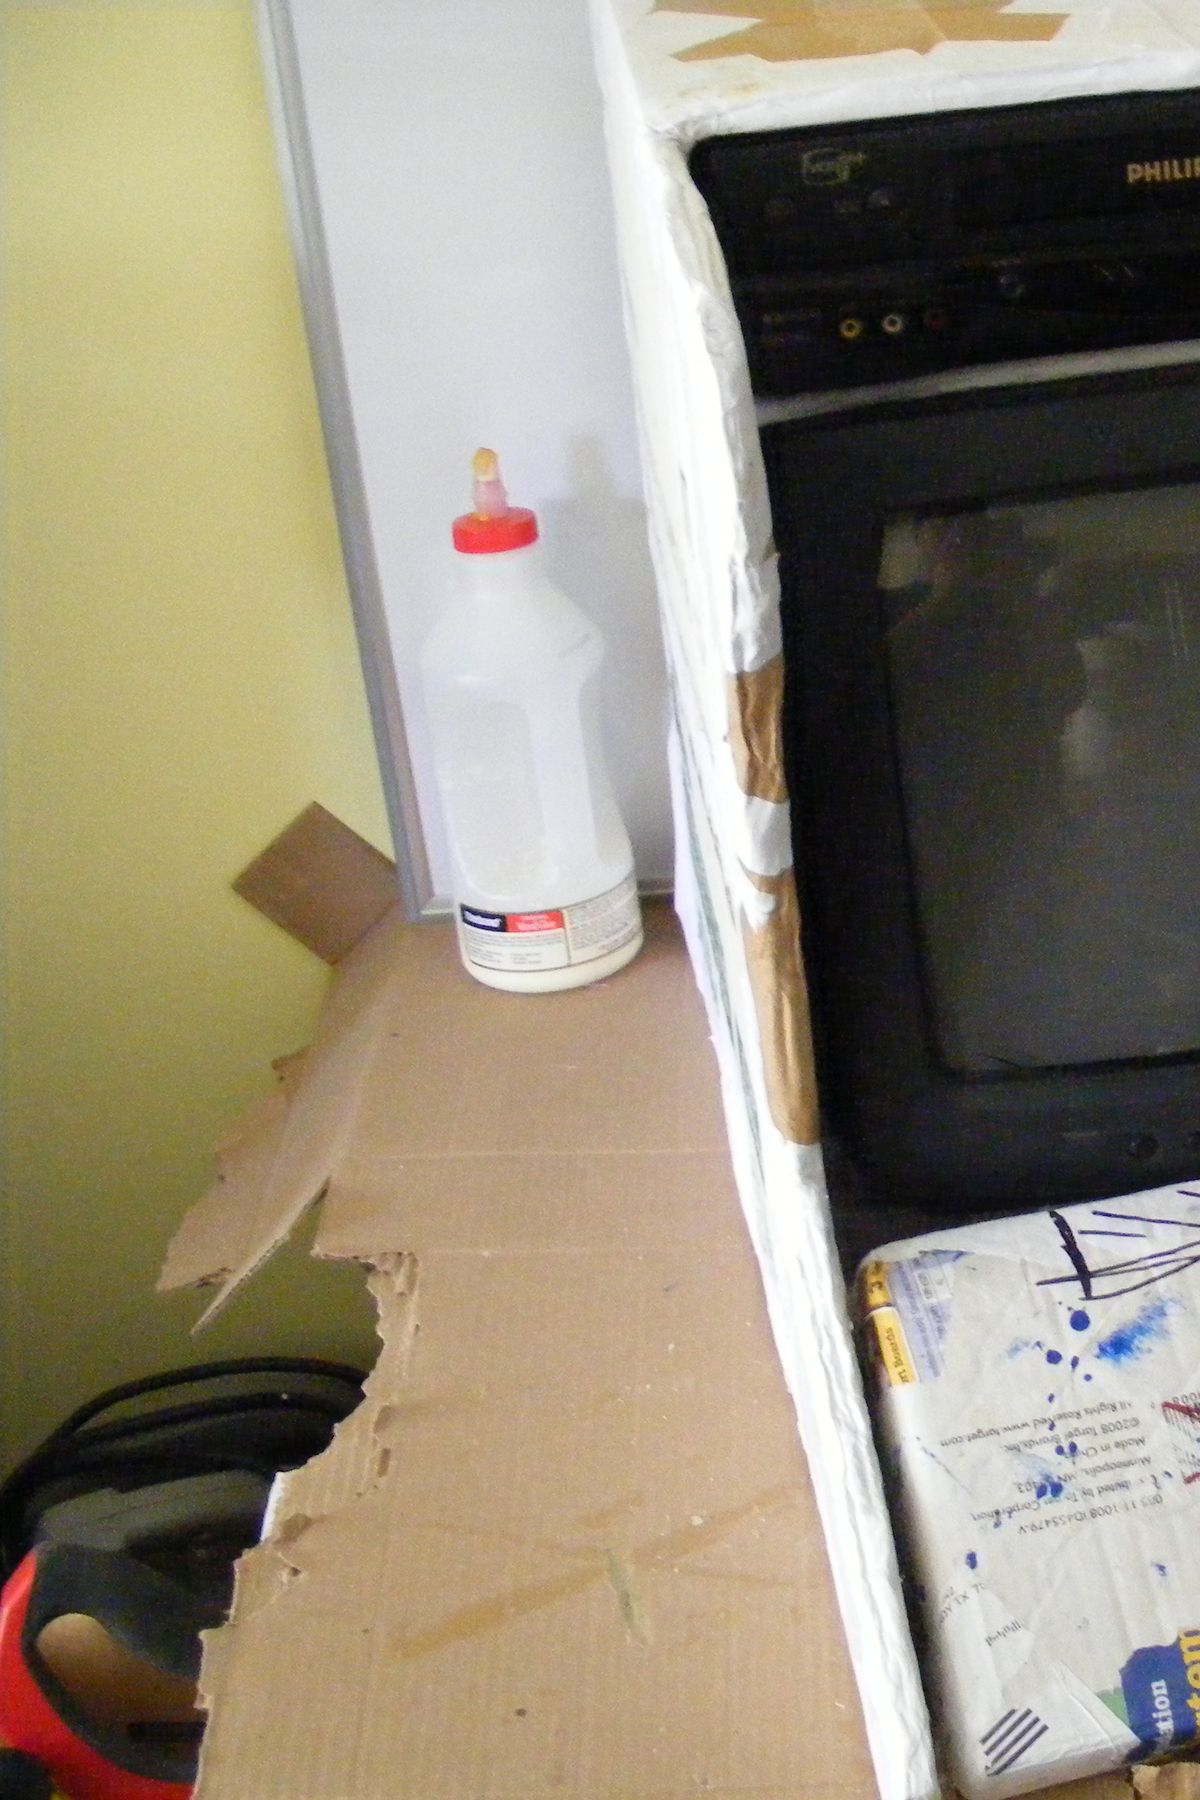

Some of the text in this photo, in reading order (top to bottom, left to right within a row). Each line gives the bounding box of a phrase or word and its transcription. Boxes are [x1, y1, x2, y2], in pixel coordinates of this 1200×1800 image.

[1083, 1399, 1117, 1418] Rights
[939, 1418, 1030, 1450] www.target.com
[1063, 1422, 1098, 1442] Target
[1099, 1442, 1111, 1454] in
[1113, 1433, 1145, 1451] Made
